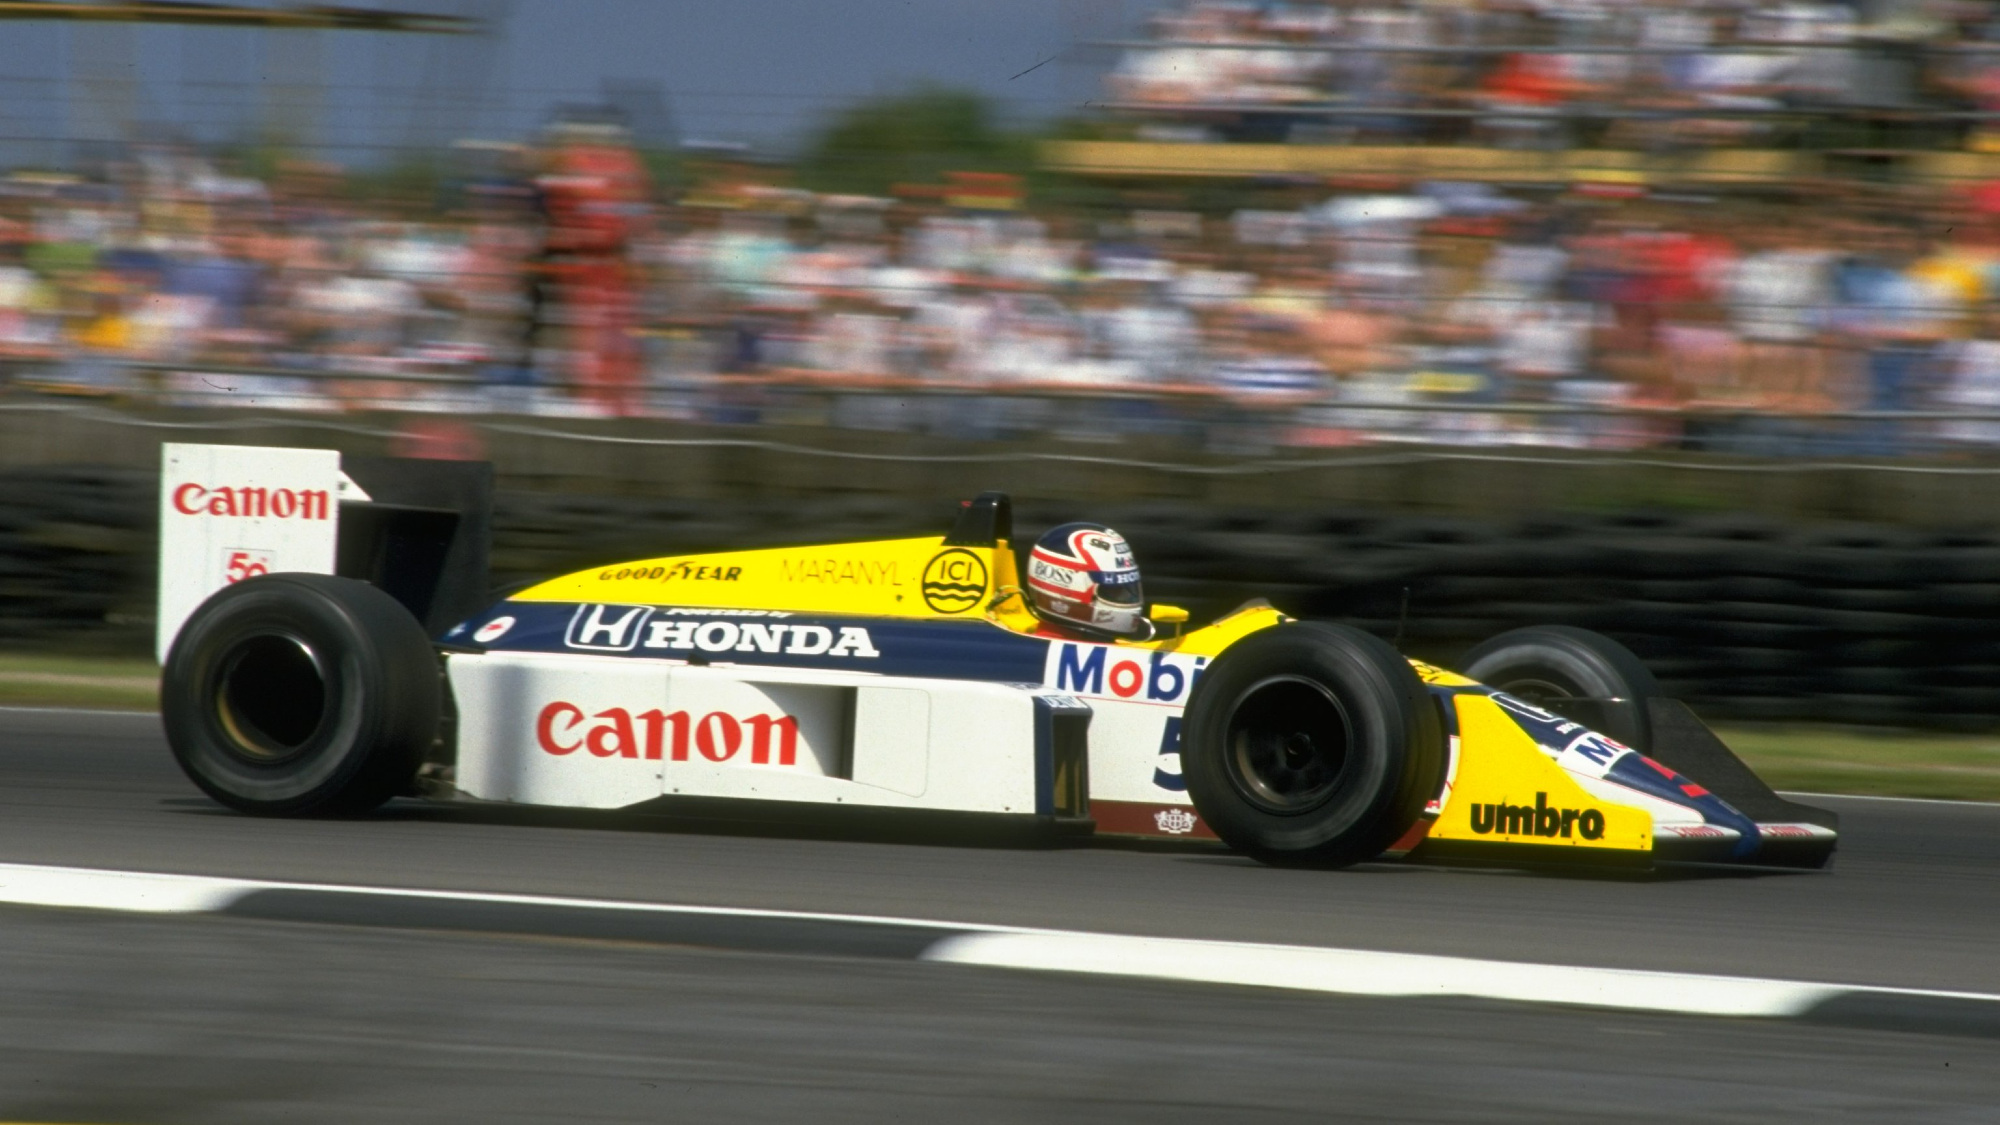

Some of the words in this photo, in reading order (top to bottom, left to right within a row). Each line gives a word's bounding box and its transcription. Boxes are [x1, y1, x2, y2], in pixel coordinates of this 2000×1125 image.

[173, 482, 329, 520] Canon
[779, 559, 903, 586] MARANYL
[940, 561, 973, 581] ICI
[1035, 561, 1074, 585] BOSS
[644, 621, 880, 658] HONDA
[536, 700, 799, 766] Canon
[1470, 791, 1605, 841] umbro
